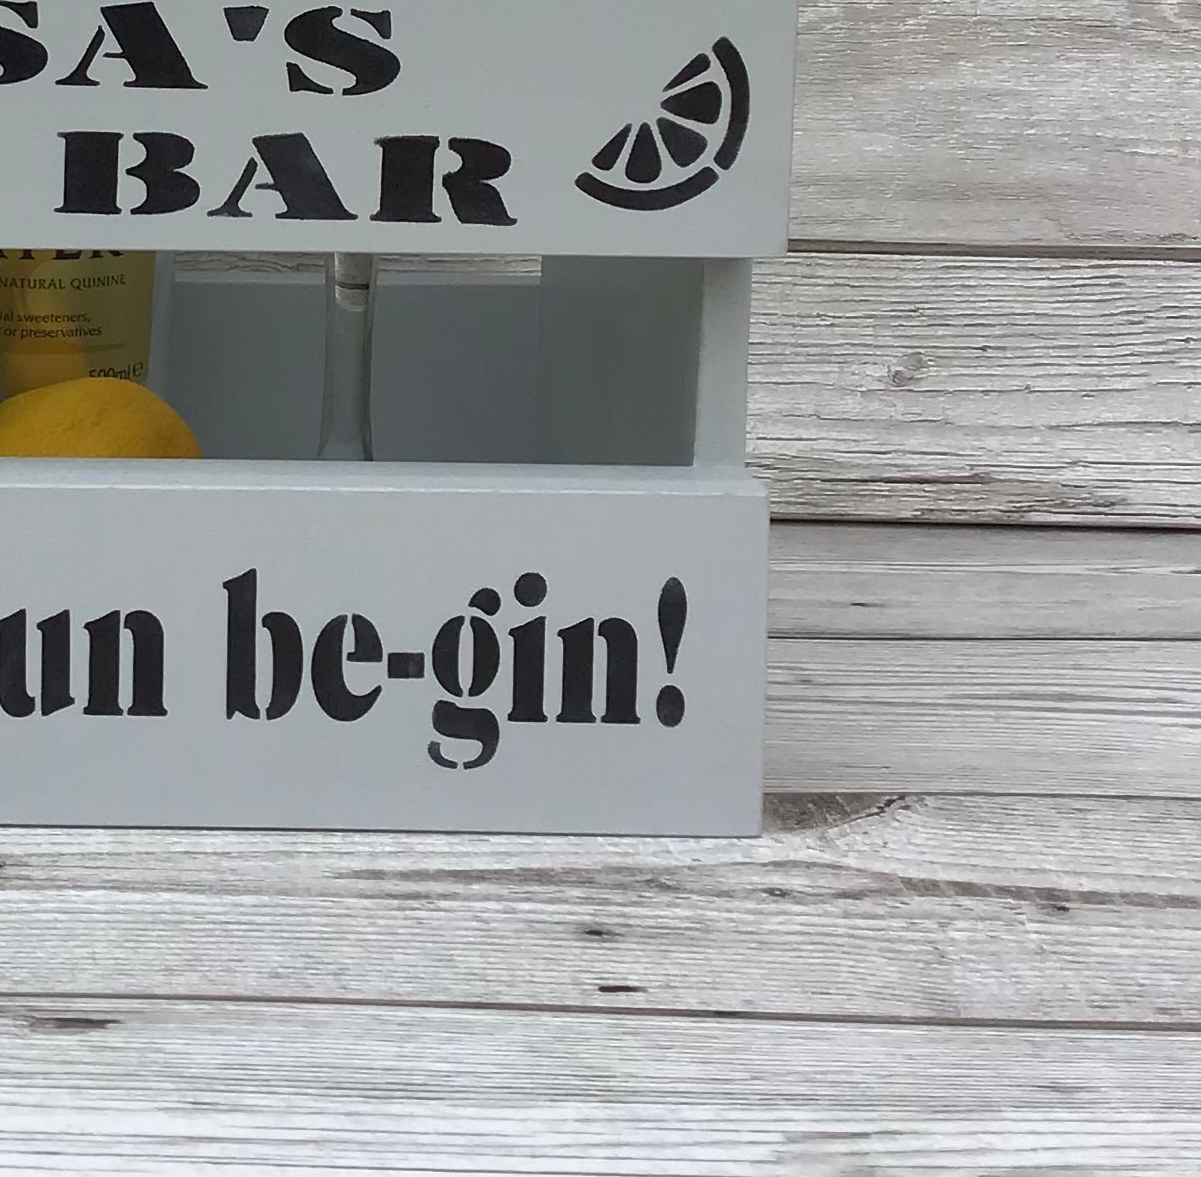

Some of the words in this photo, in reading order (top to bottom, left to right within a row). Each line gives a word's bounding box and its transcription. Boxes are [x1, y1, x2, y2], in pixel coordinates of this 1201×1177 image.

[54, 131, 517, 226] BAR
[70, 274, 126, 291] QUININE
[2, 327, 18, 337] or
[20, 324, 103, 339] preservatives
[223, 569, 687, 769] be-gin!
